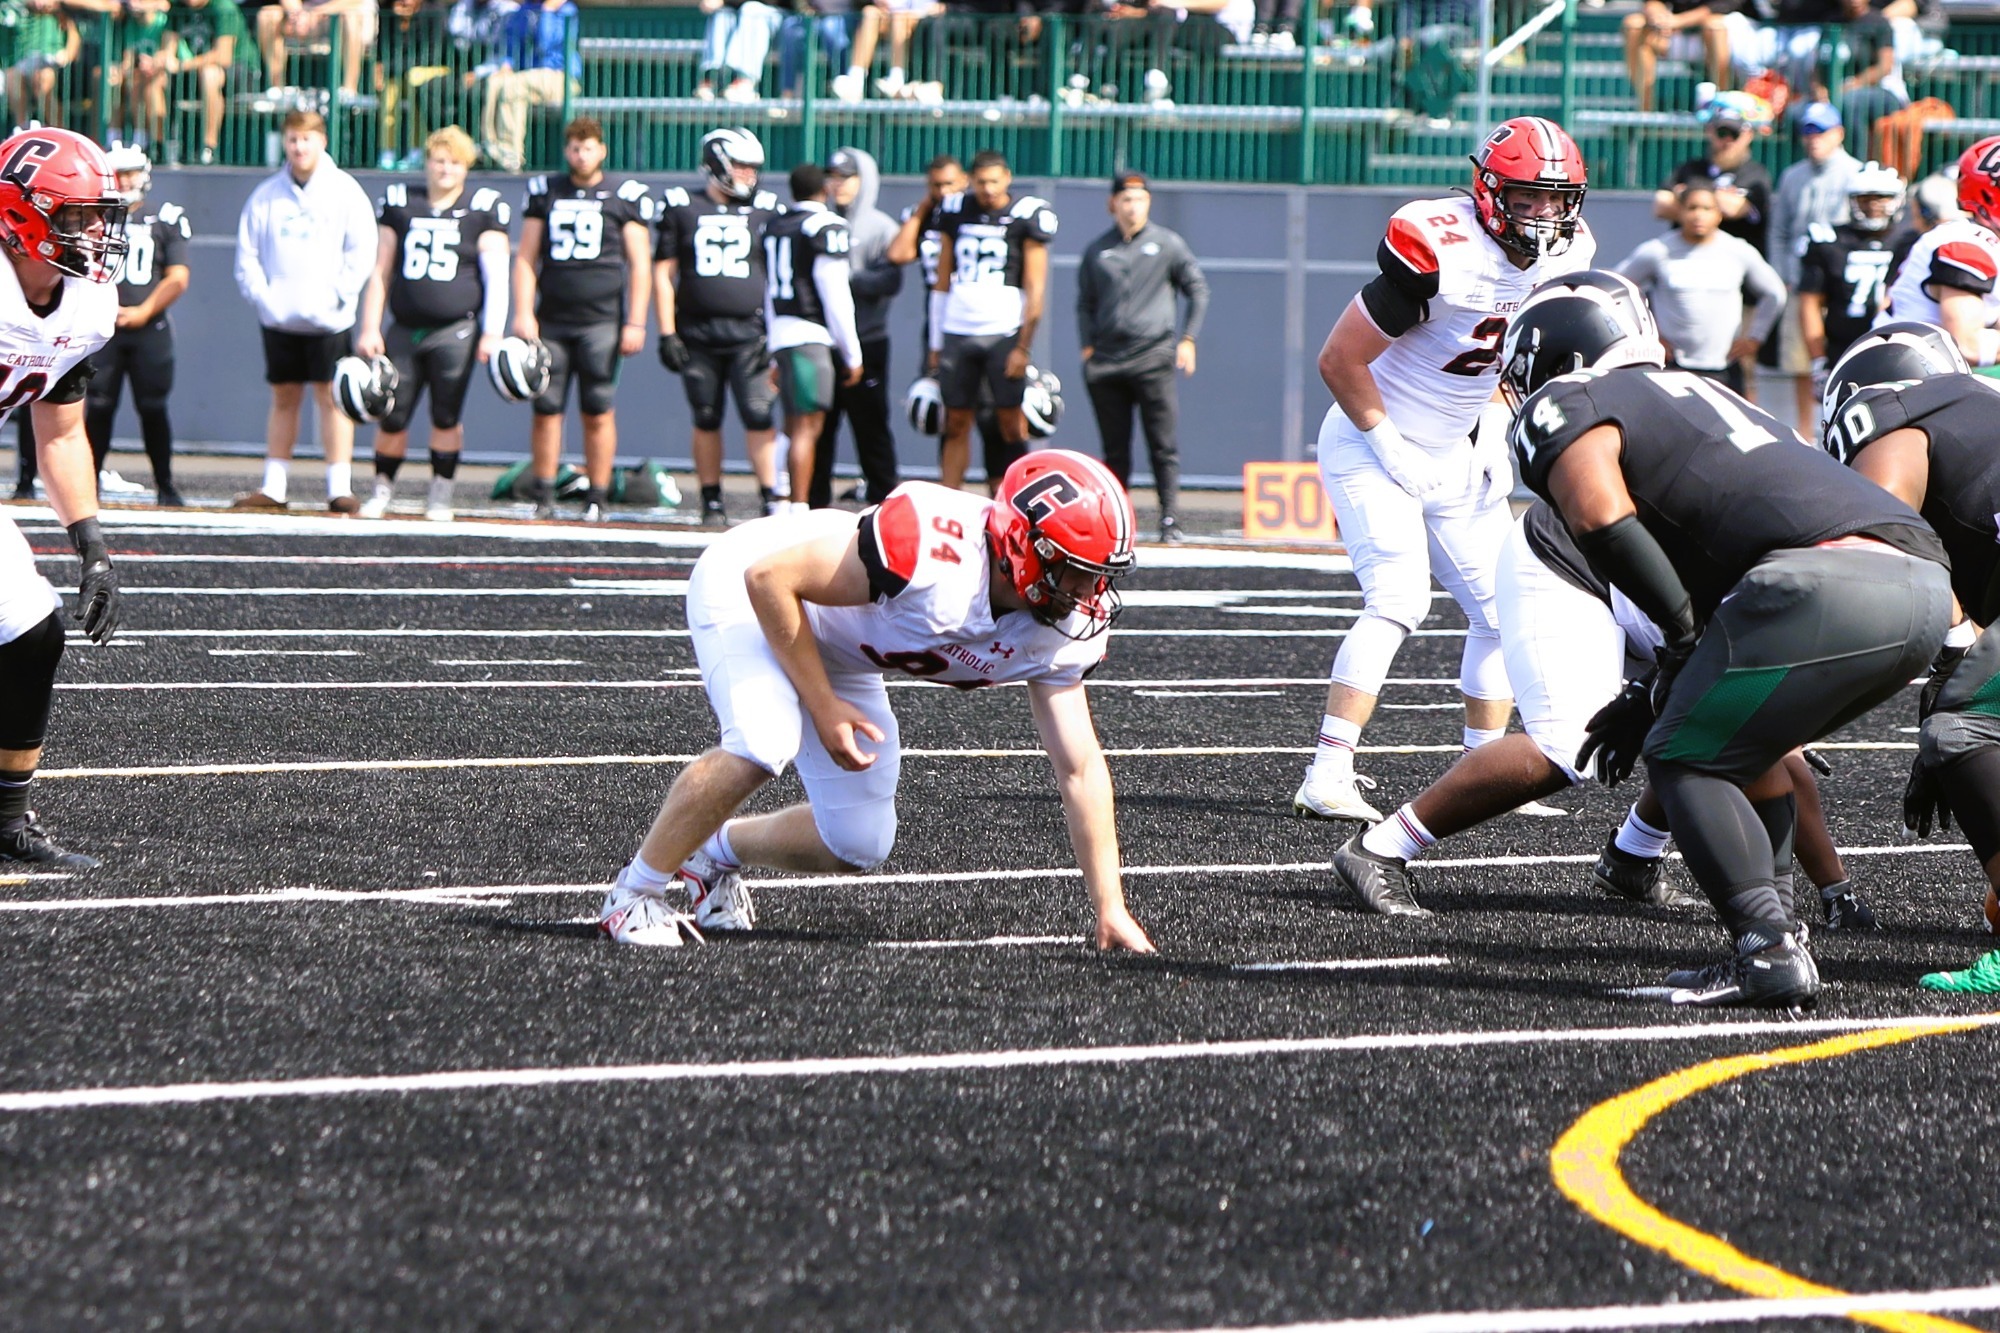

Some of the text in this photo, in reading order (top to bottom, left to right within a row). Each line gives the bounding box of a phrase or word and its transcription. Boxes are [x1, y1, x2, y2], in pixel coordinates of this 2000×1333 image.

[404, 229, 460, 281] 65
[550, 210, 603, 260] 59
[695, 225, 751, 278] 62
[1427, 213, 1468, 246] 24
[956, 236, 1008, 284] 82
[7, 353, 56, 367] CATHOLIC
[1440, 317, 1508, 376] 2
[1644, 371, 1781, 454] 7
[1012, 470, 1079, 524] C
[1257, 474, 1322, 528] 50
[930, 516, 963, 565] 94
